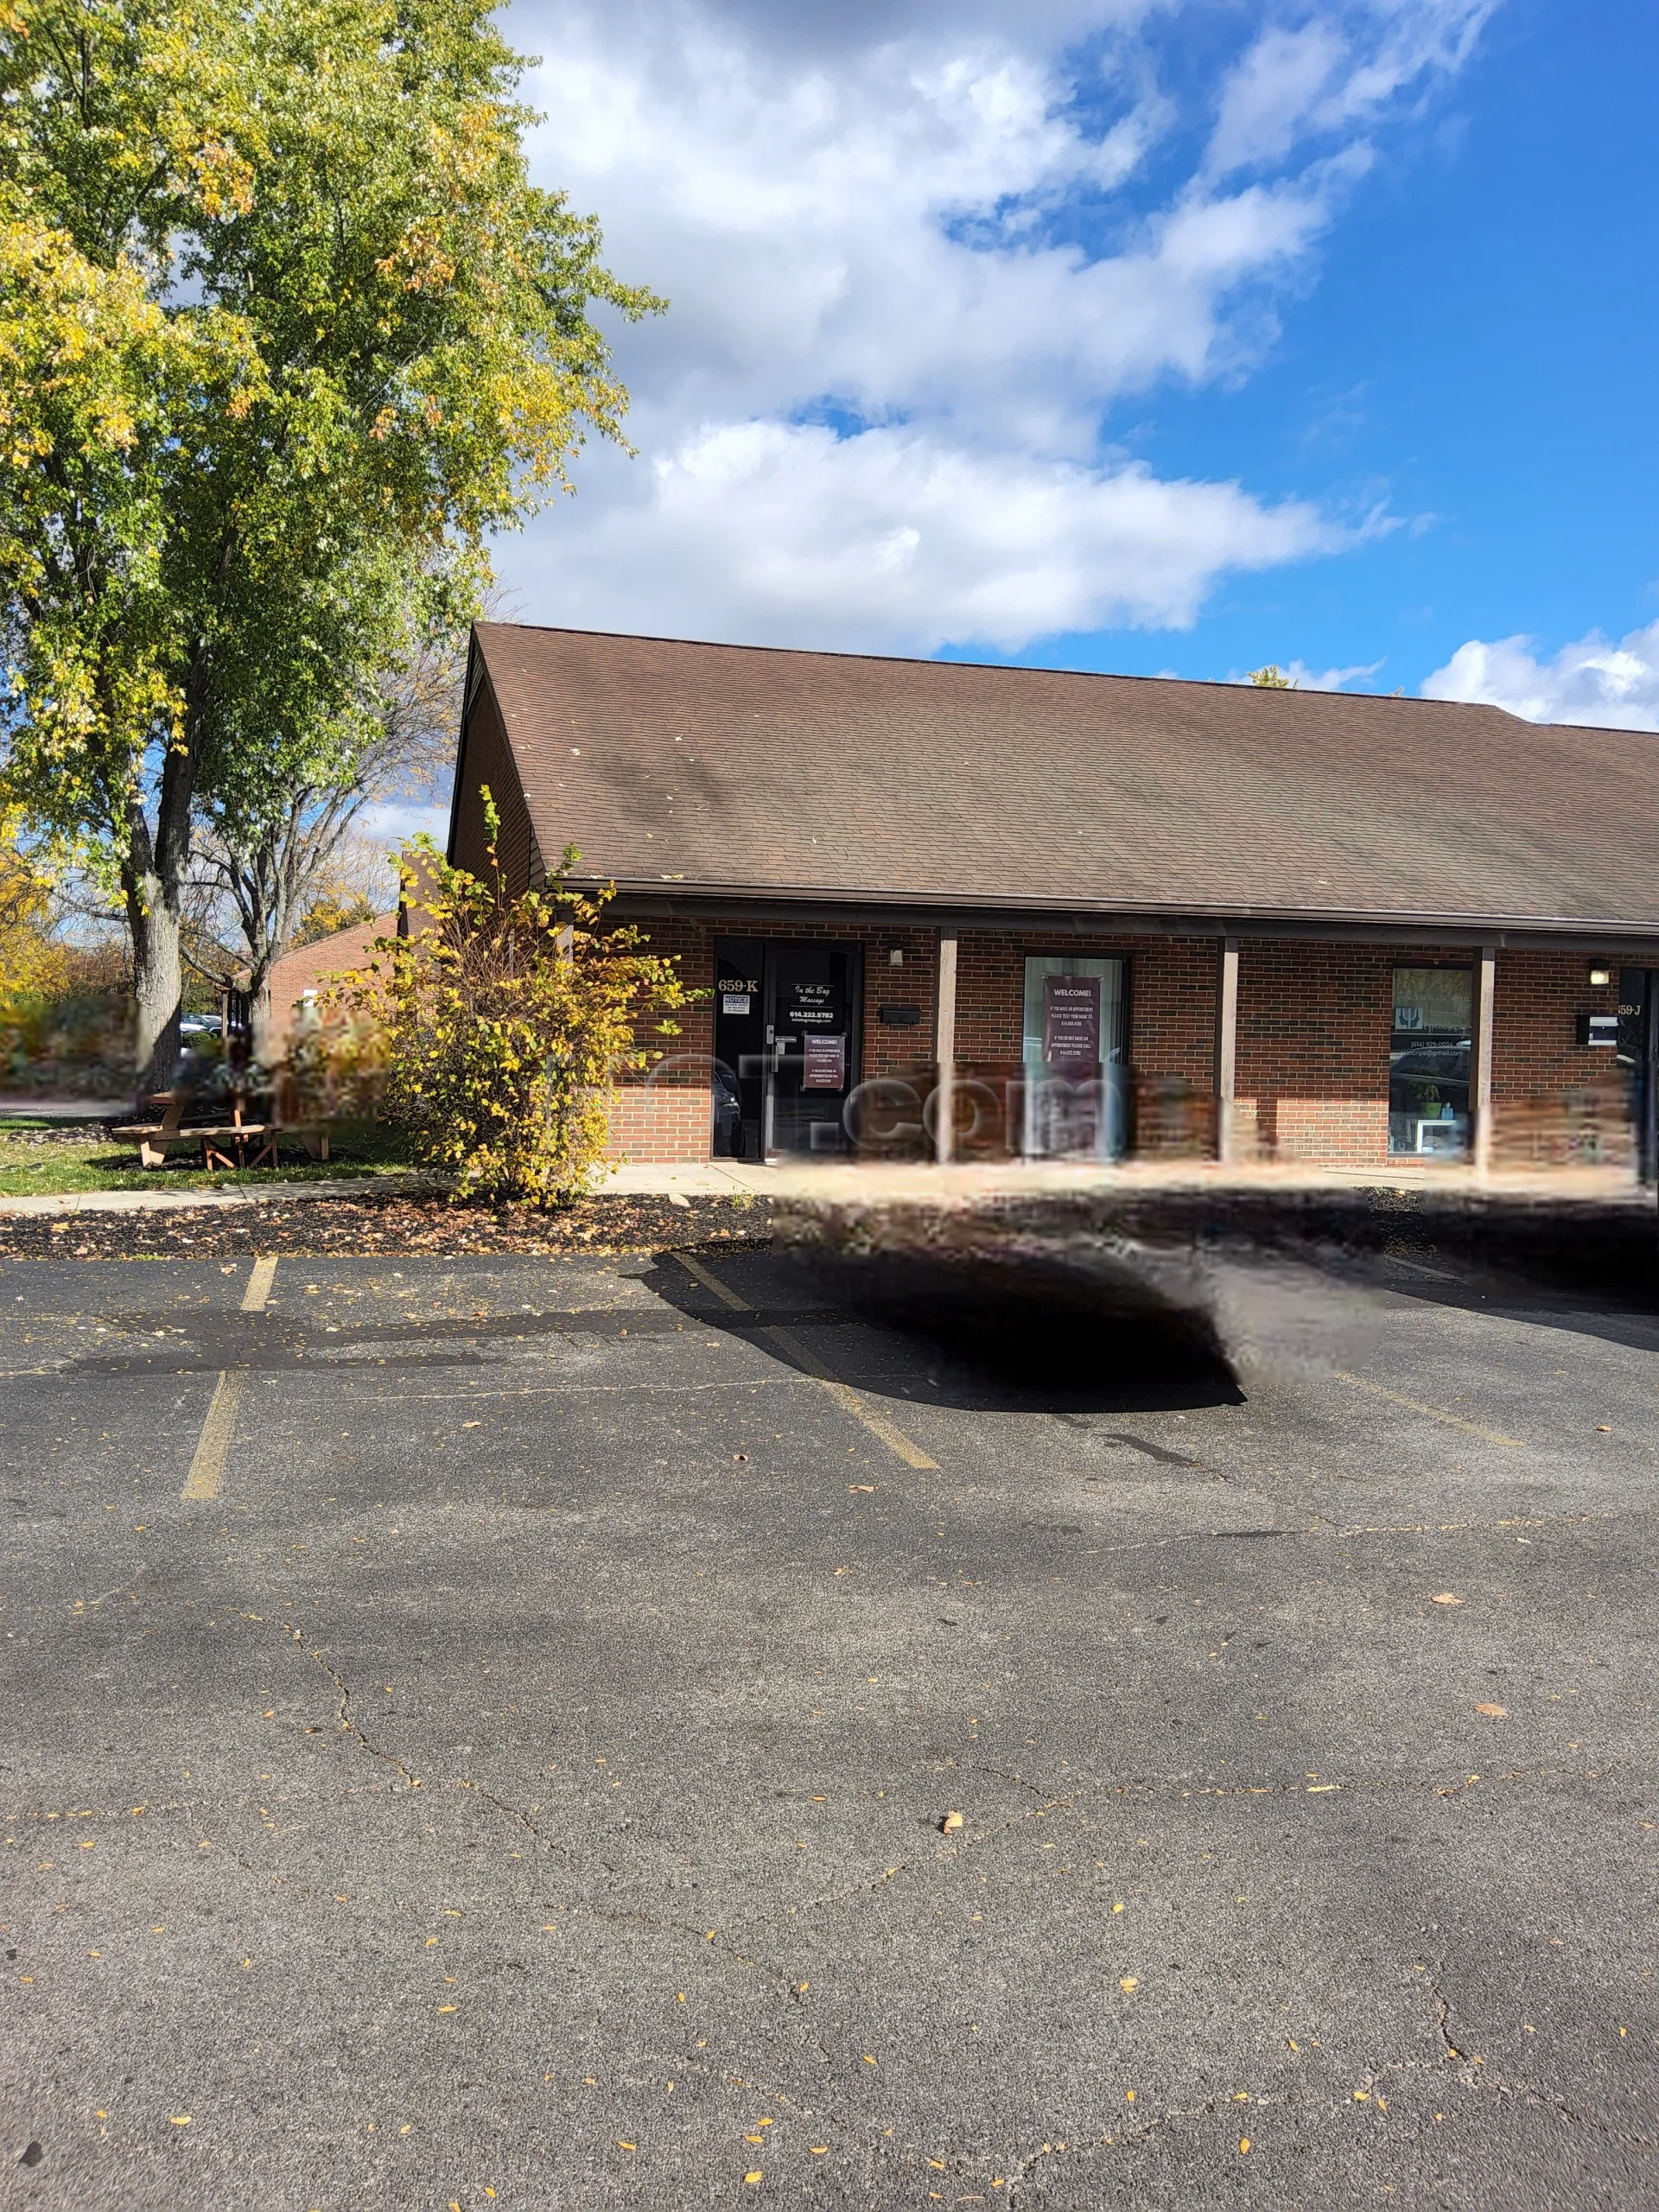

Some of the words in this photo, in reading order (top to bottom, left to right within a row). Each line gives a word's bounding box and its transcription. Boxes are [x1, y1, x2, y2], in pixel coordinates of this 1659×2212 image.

[718, 979, 759, 992] 659-K
[795, 985, 804, 994] In
[817, 986, 830, 997] Bag
[1053, 988, 1092, 997] WELCOME!
[798, 995, 825, 1006] Massage
